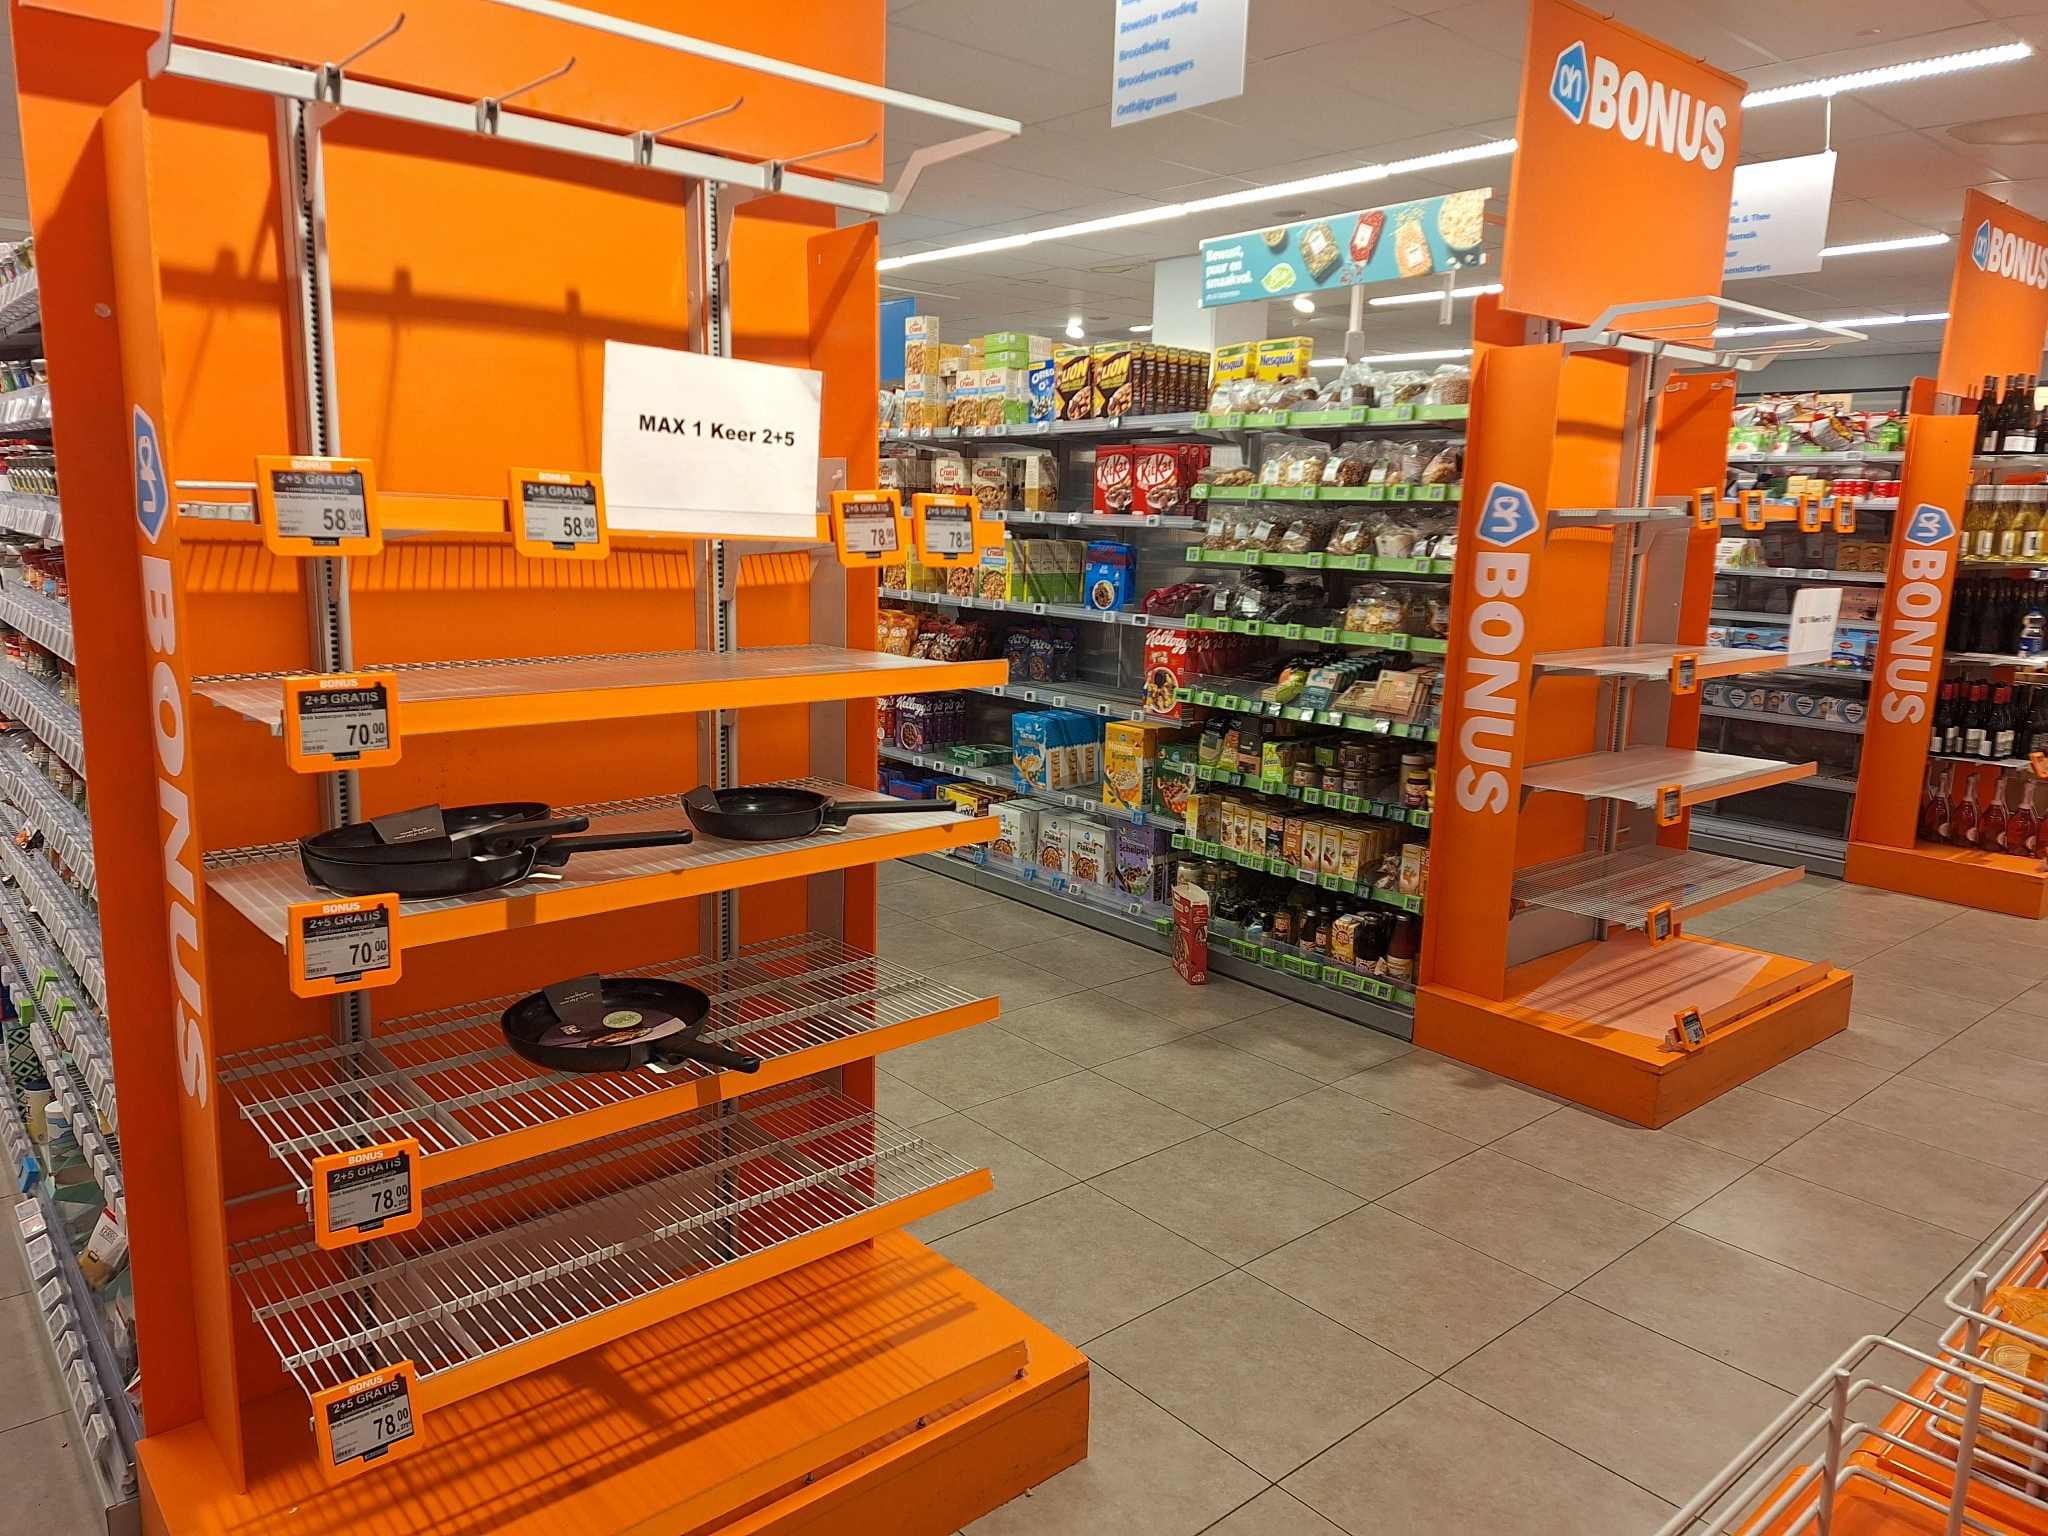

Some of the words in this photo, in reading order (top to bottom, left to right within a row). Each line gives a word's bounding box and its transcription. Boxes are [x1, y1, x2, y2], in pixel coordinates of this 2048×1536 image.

[1588, 56, 1727, 170] BONUS
[1988, 227, 2048, 289] BONUS
[1102, 352, 1131, 379] LION
[1260, 352, 1295, 367] Nesquik
[1062, 357, 1090, 383] LION
[639, 414, 685, 436] MAX
[693, 421, 702, 437] 1
[711, 423, 756, 444] Keer
[762, 429, 795, 447] 2+5
[940, 467, 959, 477] Cruesli
[976, 468, 1001, 477] Cruesli
[1142, 455, 1172, 483] KitKat
[278, 473, 302, 485] 2+5
[305, 474, 355, 487] GRATIS
[527, 485, 546, 495] 2+5
[549, 486, 589, 497] GRATIS
[1881, 549, 1947, 724] BONUS
[320, 679, 359, 688] BONUS
[1456, 552, 1531, 815] BONUS
[305, 694, 327, 706] 2+5
[330, 691, 379, 705] GRATIS
[142, 555, 207, 1111] BONUS
[1044, 831, 1062, 843] Flakes
[1077, 842, 1097, 855] Flakes
[322, 902, 361, 914] BONUS
[309, 919, 331, 929] 2+5
[334, 910, 381, 925] GRATIS
[348, 1150, 384, 1165] BONUS
[333, 1171, 354, 1183] 2+5
[357, 1157, 401, 1177] GRATIS
[348, 1375, 384, 1393] BONUS
[333, 1399, 354, 1414] 2+5
[356, 1381, 399, 1405] GRATIS
